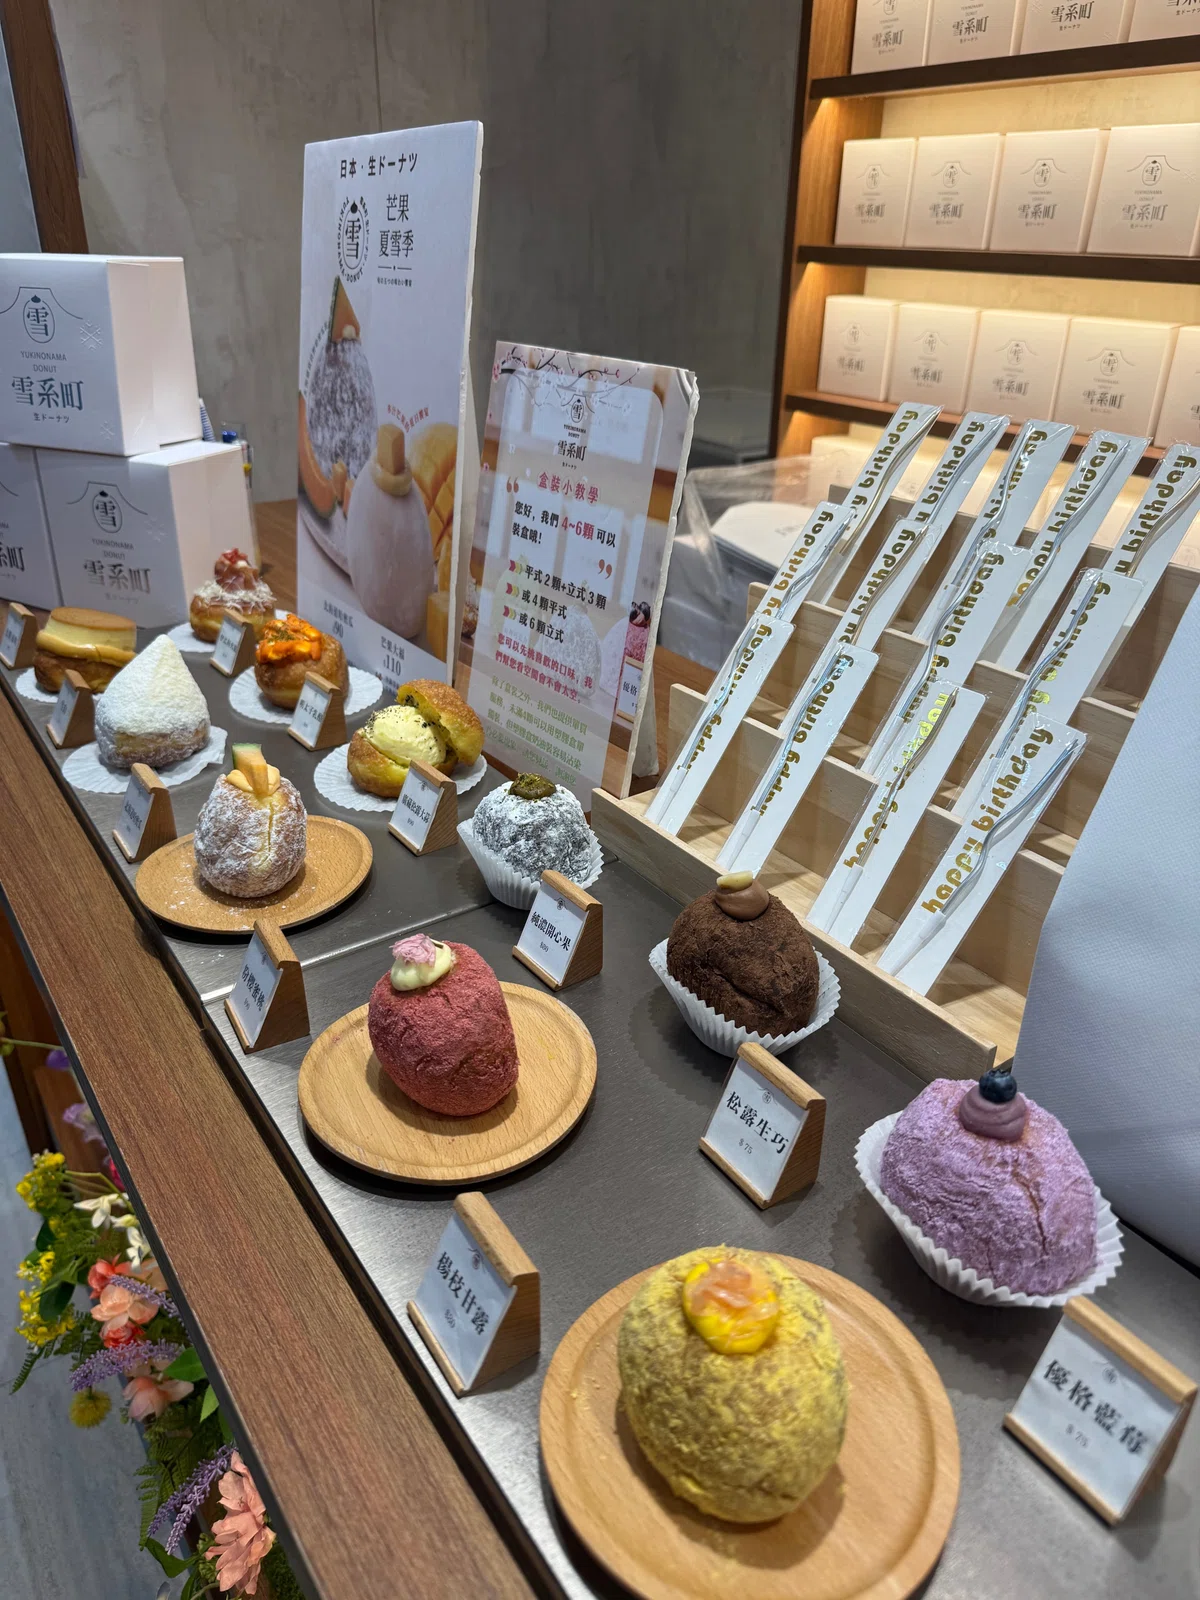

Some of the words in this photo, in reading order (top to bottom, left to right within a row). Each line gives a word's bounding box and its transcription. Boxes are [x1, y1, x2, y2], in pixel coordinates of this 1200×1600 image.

[1051, 1, 1095, 23] 雪系町
[872, 29, 904, 49] 雪系町
[952, 16, 989, 37] 雪系町
[386, 194, 409, 222] 芒果
[1018, 203, 1057, 220] 雪系町
[1122, 203, 1168, 221] 雪系町
[345, 218, 361, 259] 雪
[379, 230, 414, 257] 夏雪季
[26, 307, 49, 337] 雪
[20, 351, 67, 362] YUKINONAMA
[33, 363, 57, 373] DONUT
[11, 376, 84, 411] 雪系町
[33, 413, 70, 423] 生ドーナツ
[573, 404, 583, 420] 雪
[558, 440, 587, 461] 雪系町
[858, 410, 919, 490] birthday
[921, 420, 985, 505] birthday
[538, 471, 599, 504] 盒裝小教學
[95, 500, 117, 528] 雪
[1121, 454, 1197, 553] birthday
[91, 538, 134, 550] YUKINONAMA
[774, 511, 834, 592] birthday
[84, 559, 151, 594] 雪系町
[921, 836, 984, 914] happy
[971, 728, 1055, 833] birthday
[531, 911, 571, 951] 純濃開心果
[726, 1091, 790, 1154] 松露生巧
[738, 1138, 753, 1154] $75
[437, 1251, 489, 1335] 楊枝甘露
